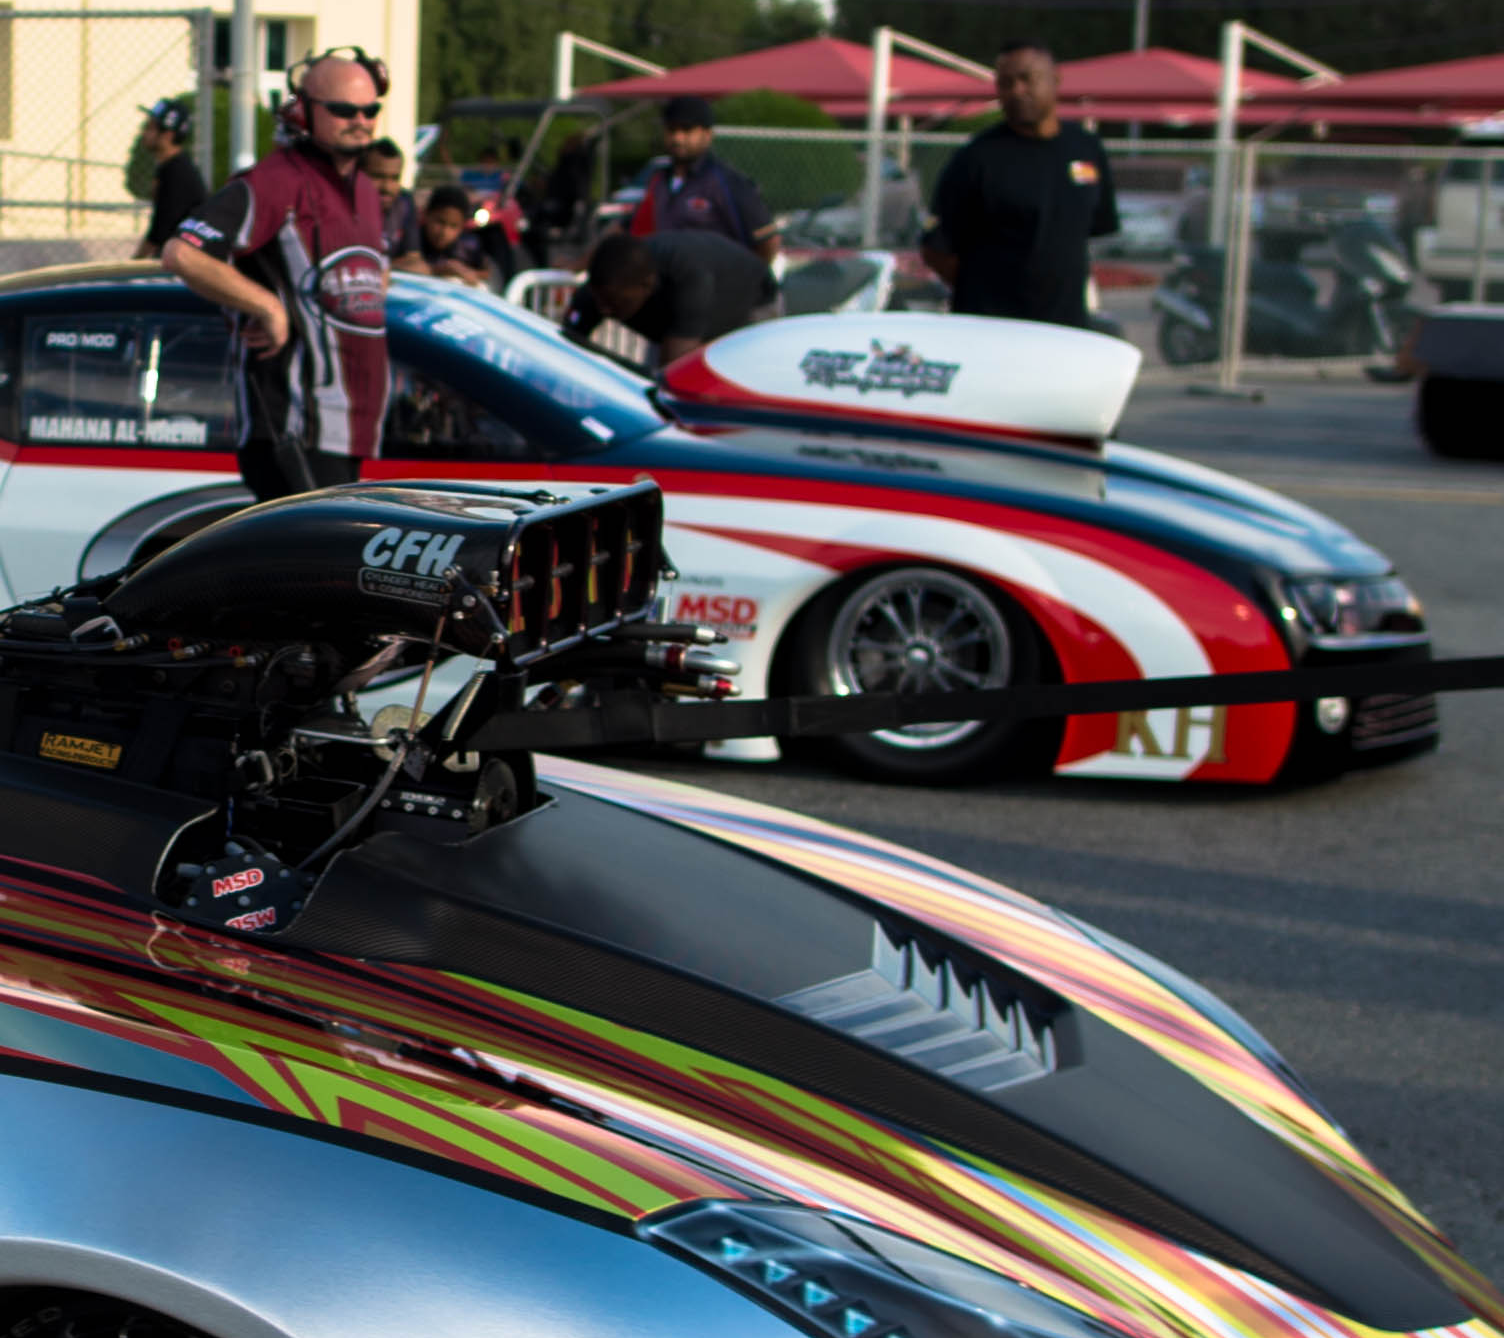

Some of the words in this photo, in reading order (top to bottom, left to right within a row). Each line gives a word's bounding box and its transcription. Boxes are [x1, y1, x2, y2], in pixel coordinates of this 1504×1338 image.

[46, 332, 78, 347] PRO
[80, 333, 117, 348] MOD
[29, 416, 112, 441] MAHANA
[361, 527, 467, 578] CFH
[675, 593, 760, 625] MSD
[43, 732, 117, 758] RAMJET
[211, 867, 264, 898] MSD
